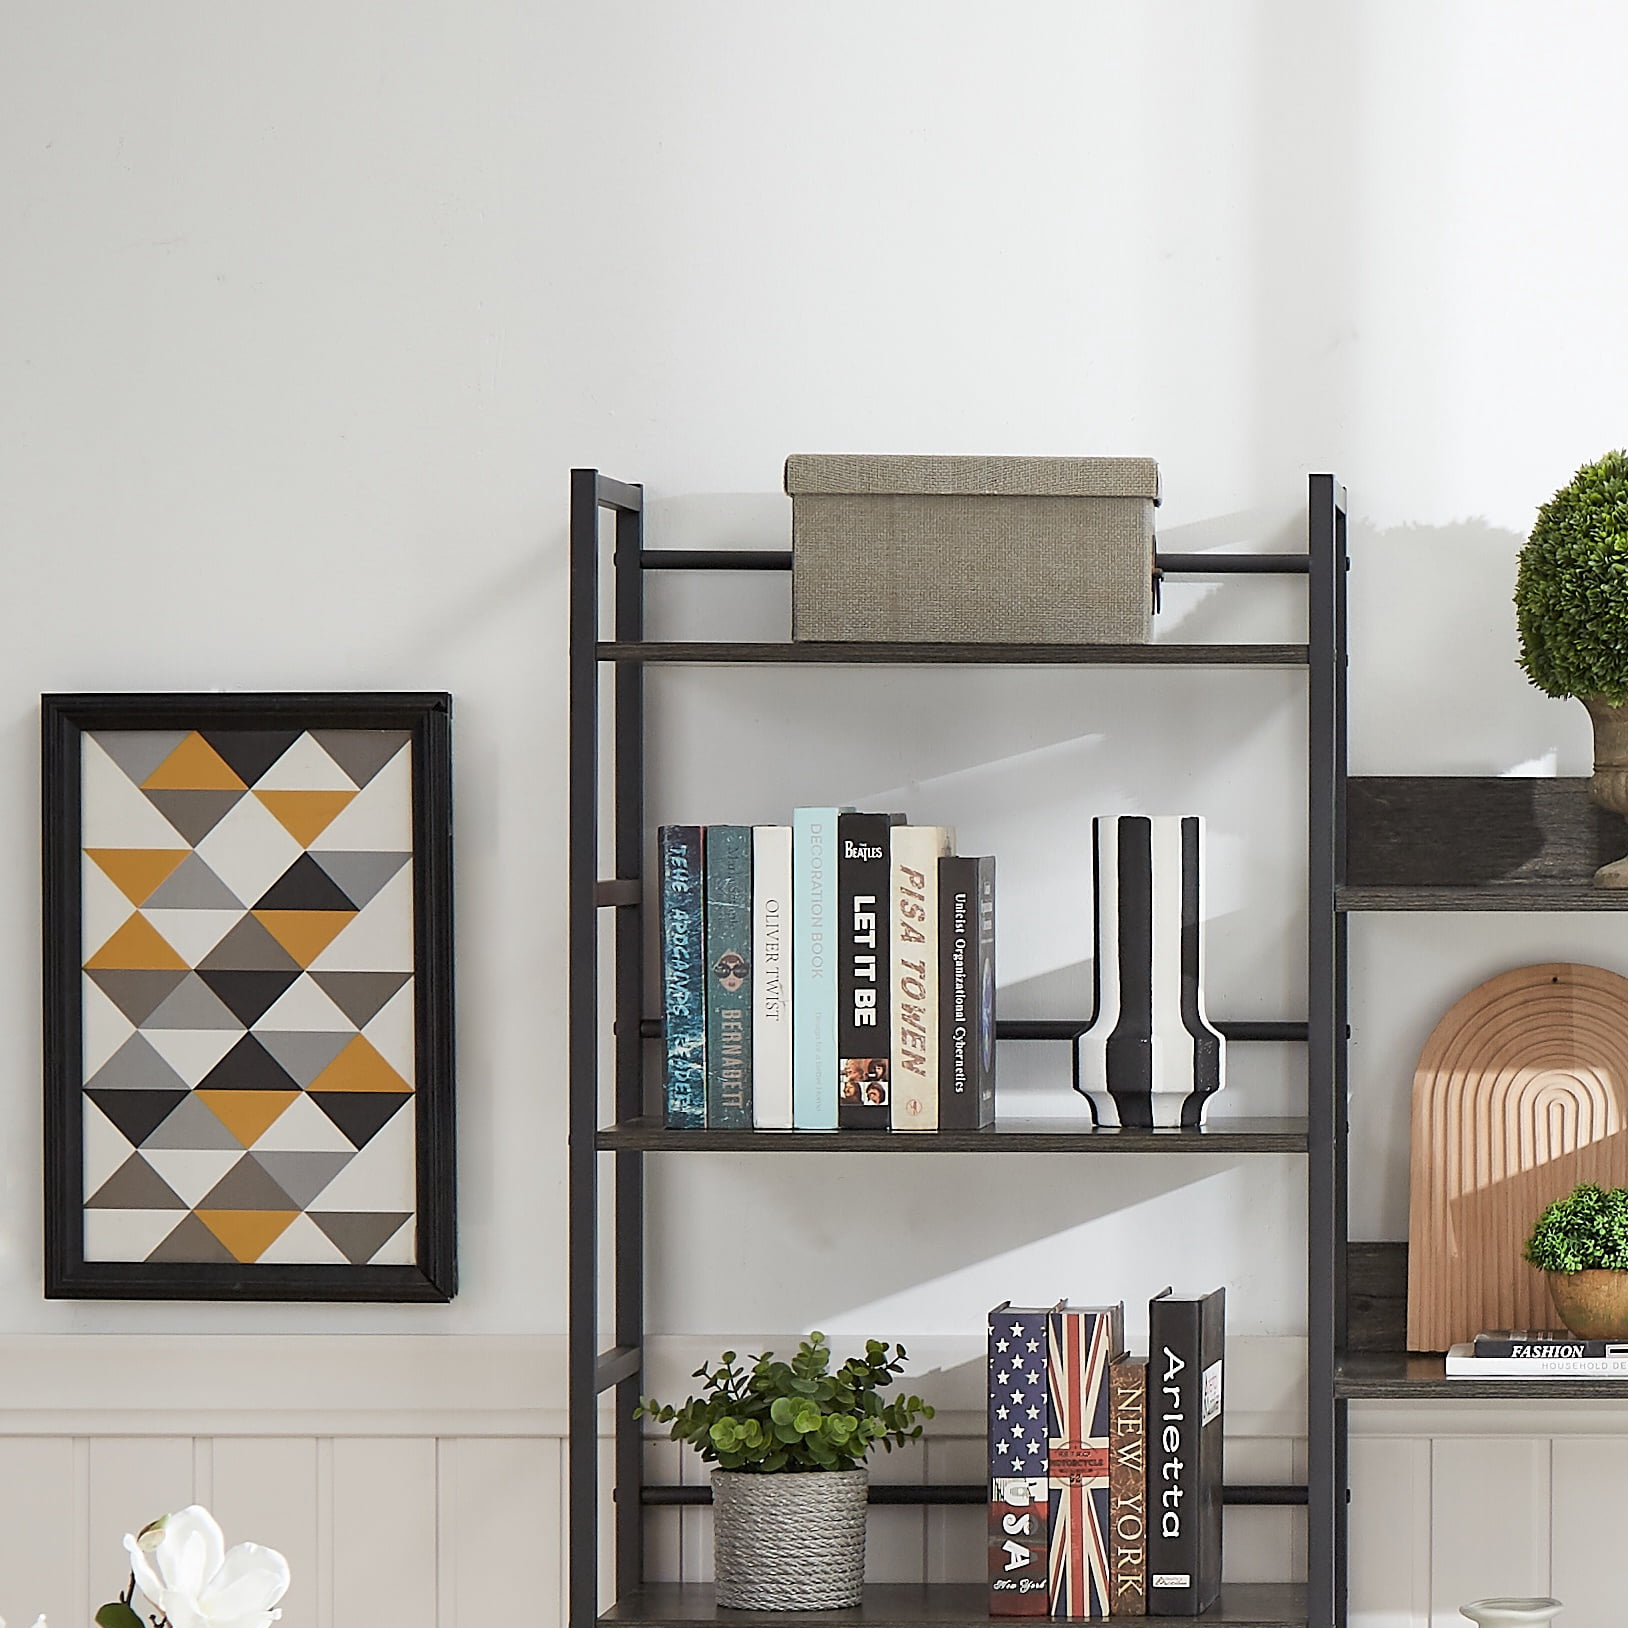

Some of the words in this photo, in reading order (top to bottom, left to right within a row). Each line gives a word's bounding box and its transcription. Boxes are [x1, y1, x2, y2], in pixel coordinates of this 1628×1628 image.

[810, 823, 823, 928] DECORATION
[899, 864, 926, 944] PISA
[764, 899, 780, 963] OLIVER
[853, 895, 876, 949] LET
[954, 893, 967, 934] Unicist
[811, 933, 823, 979] BOOK
[854, 955, 876, 982] IT
[952, 937, 967, 1022] Organizational
[765, 967, 781, 1022] TWIST
[854, 988, 877, 1027] BE
[952, 1026, 967, 1093] Cybernetics
[1509, 1345, 1585, 1359] FASHION
[1541, 1361, 1609, 1370] HOUSEHOLD
[1117, 1387, 1143, 1473] NEW
[1162, 1346, 1185, 1538] Arletta
[1001, 1480, 1031, 1572] USA
[1117, 1493, 1143, 1597] YORK
[993, 1579, 1017, 1590] New
[1019, 1578, 1047, 1594] York
